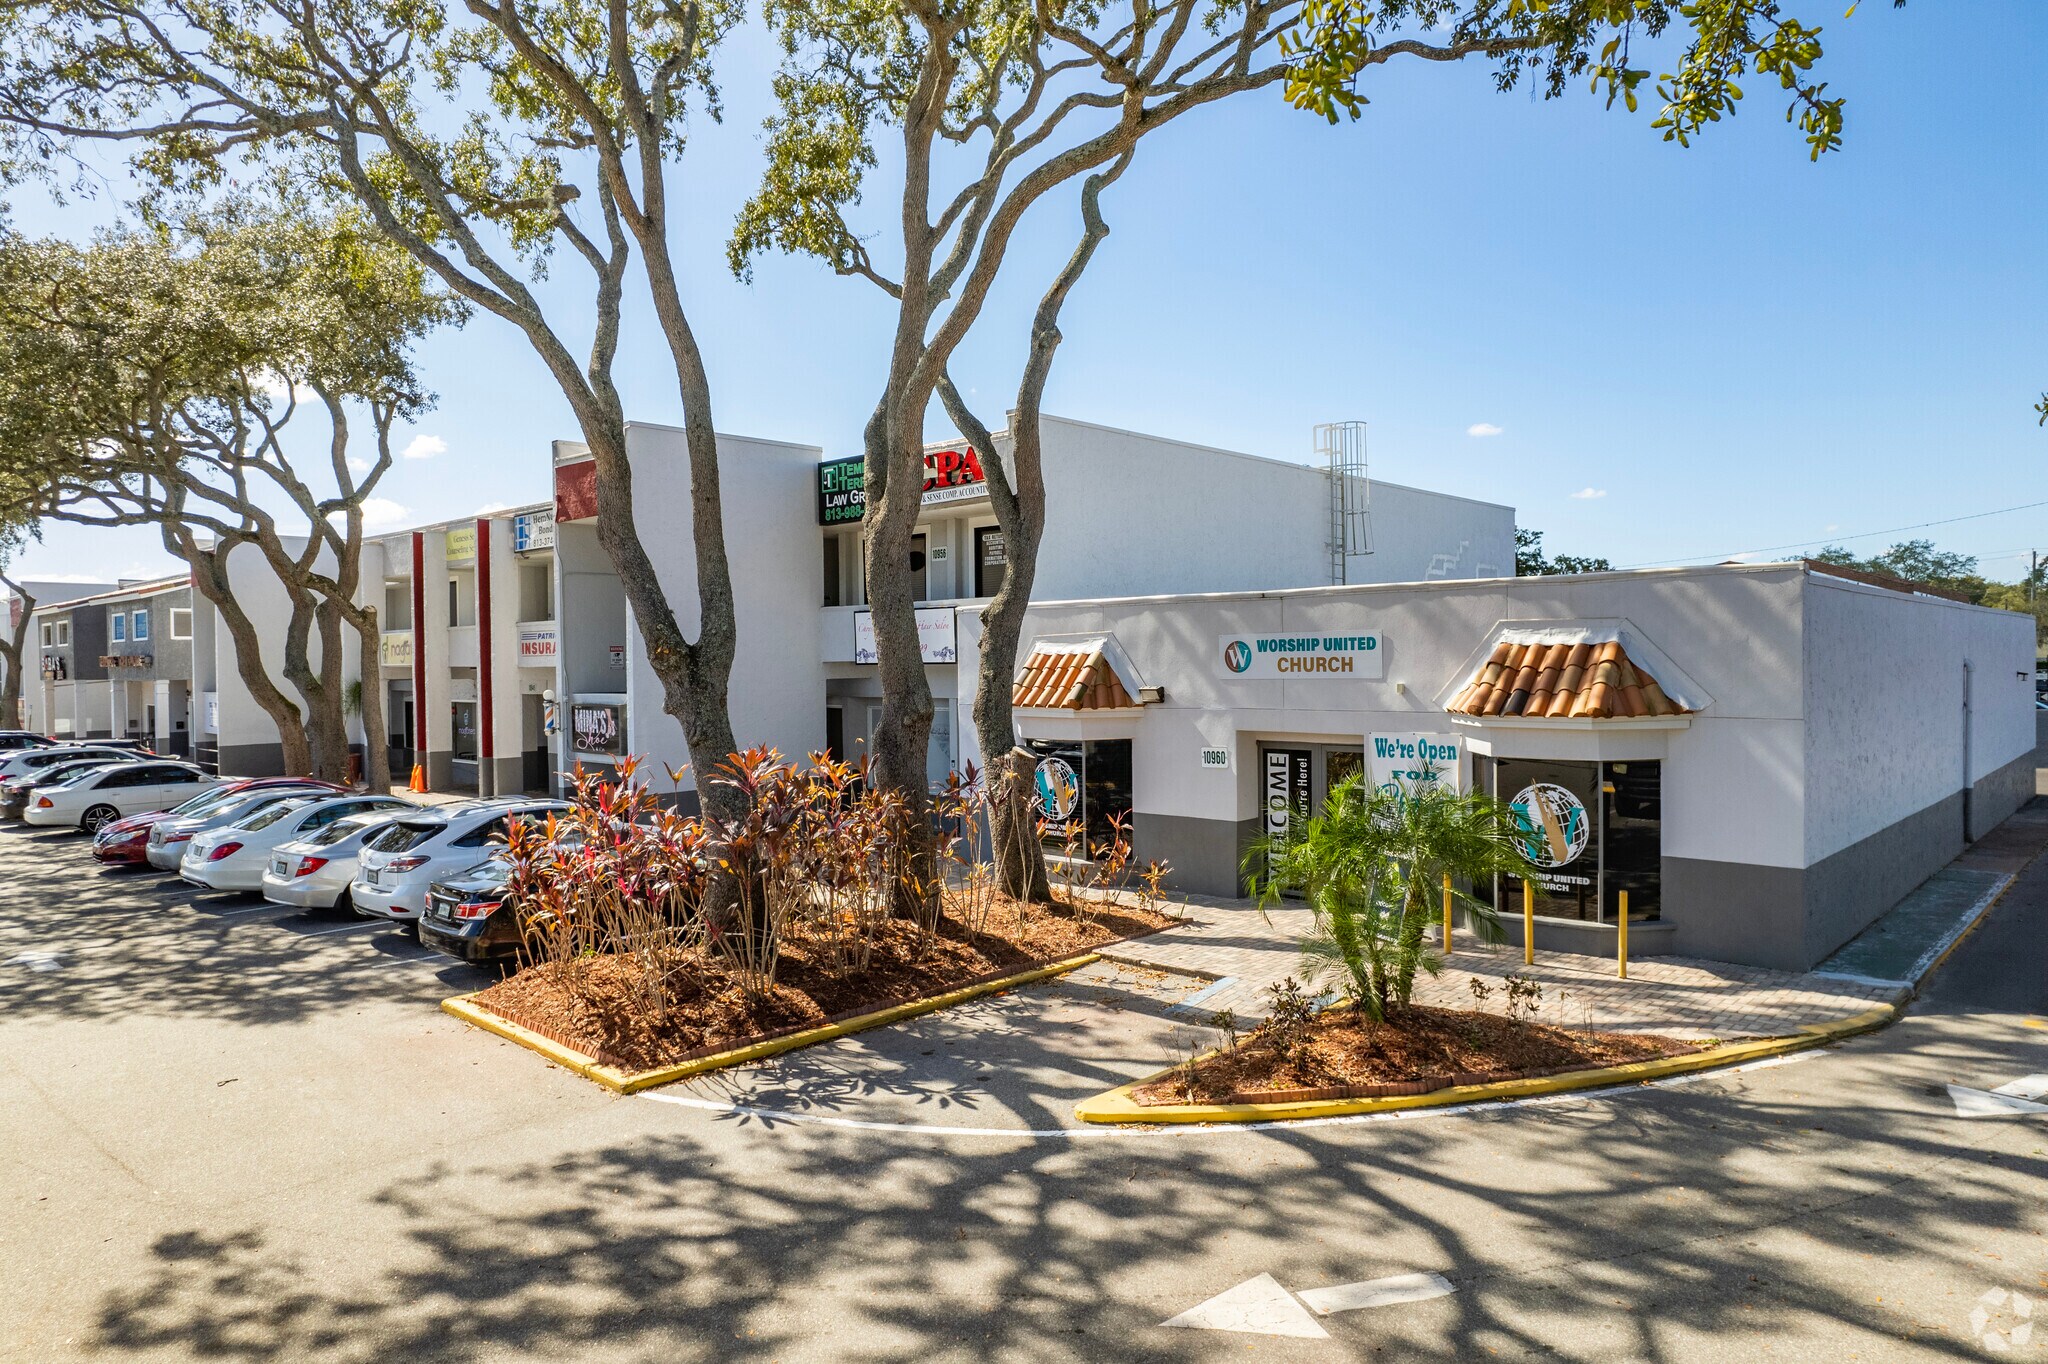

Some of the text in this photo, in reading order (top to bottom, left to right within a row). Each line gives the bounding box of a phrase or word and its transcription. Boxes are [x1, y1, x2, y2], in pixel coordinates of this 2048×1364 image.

[826, 493, 848, 508] LAW
[927, 492, 942, 502] SENSE
[1257, 636, 1376, 652] WORSHIP UNITED
[1276, 656, 1354, 673] CHURCH
[1203, 750, 1226, 765] 10960
[1375, 738, 1457, 766] We're Open
[1296, 758, 1308, 787] Here!
[1391, 770, 1438, 781] FOR
[1553, 873, 1591, 886] UNITED
